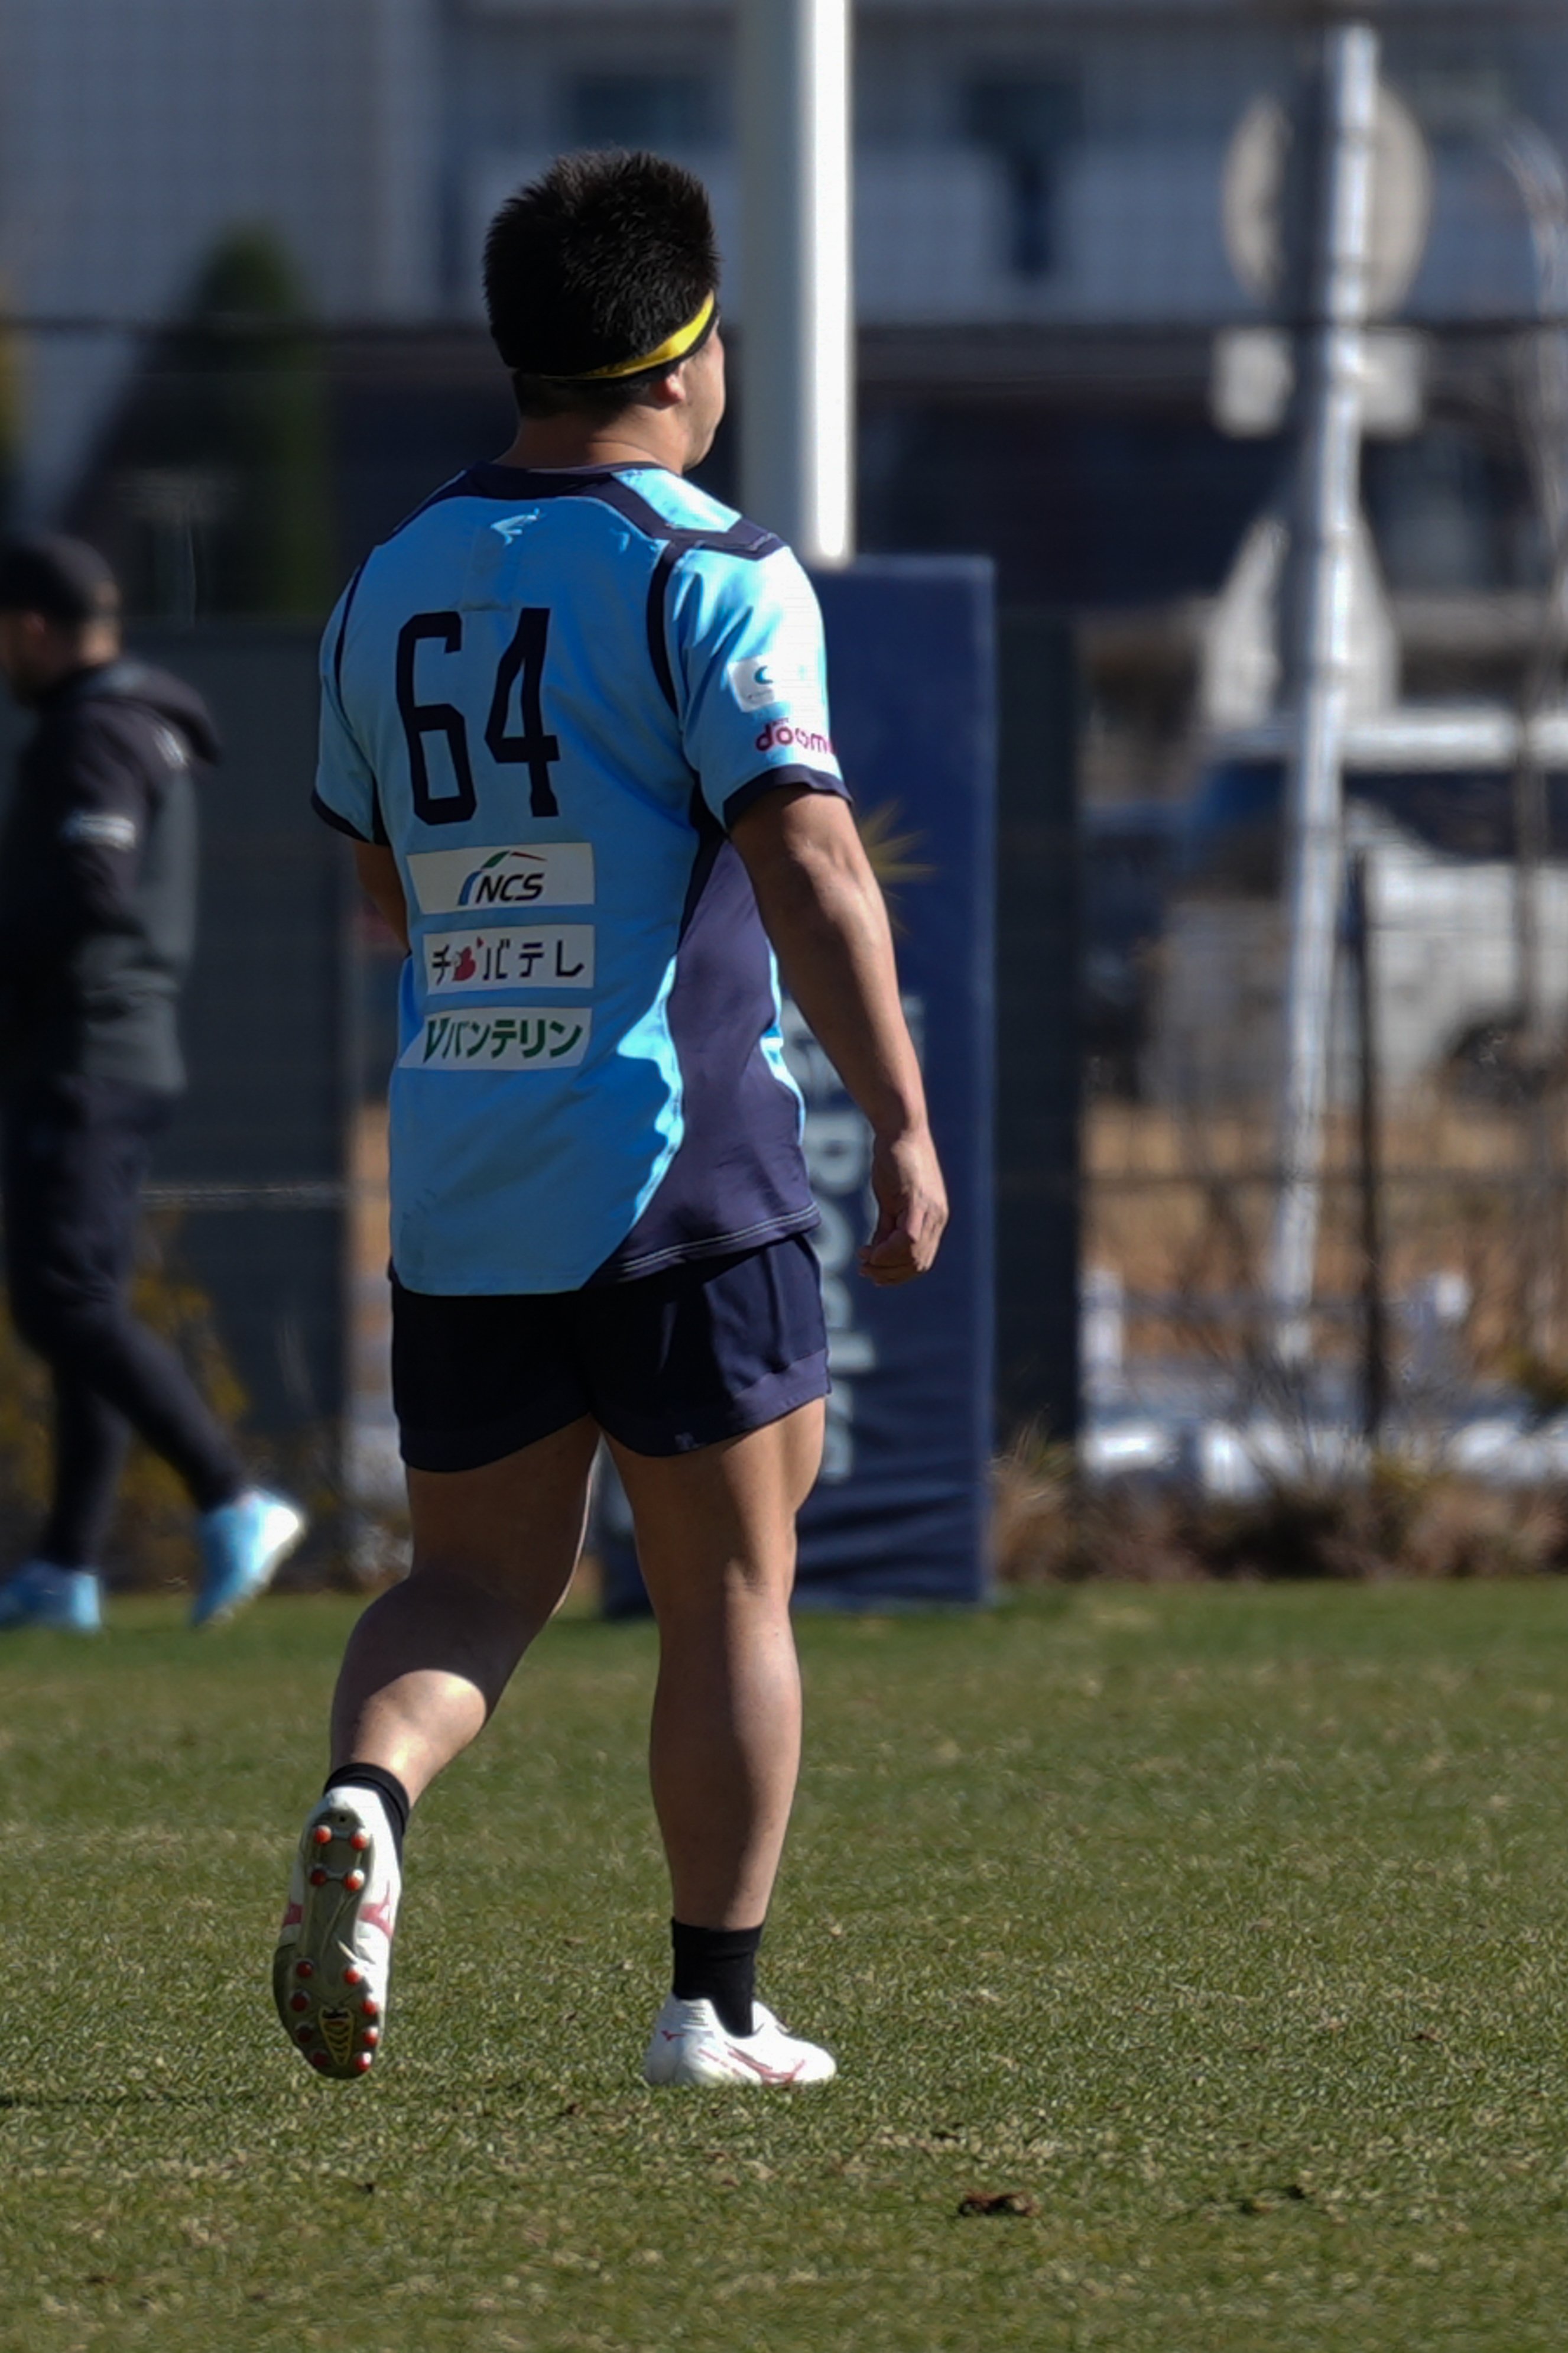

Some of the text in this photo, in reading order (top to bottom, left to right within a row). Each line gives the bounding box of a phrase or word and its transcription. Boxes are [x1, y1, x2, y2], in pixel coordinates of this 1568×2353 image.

[396, 607, 560, 825] 64
[475, 873, 545, 904] NCS
[431, 938, 585, 986] チバテレ
